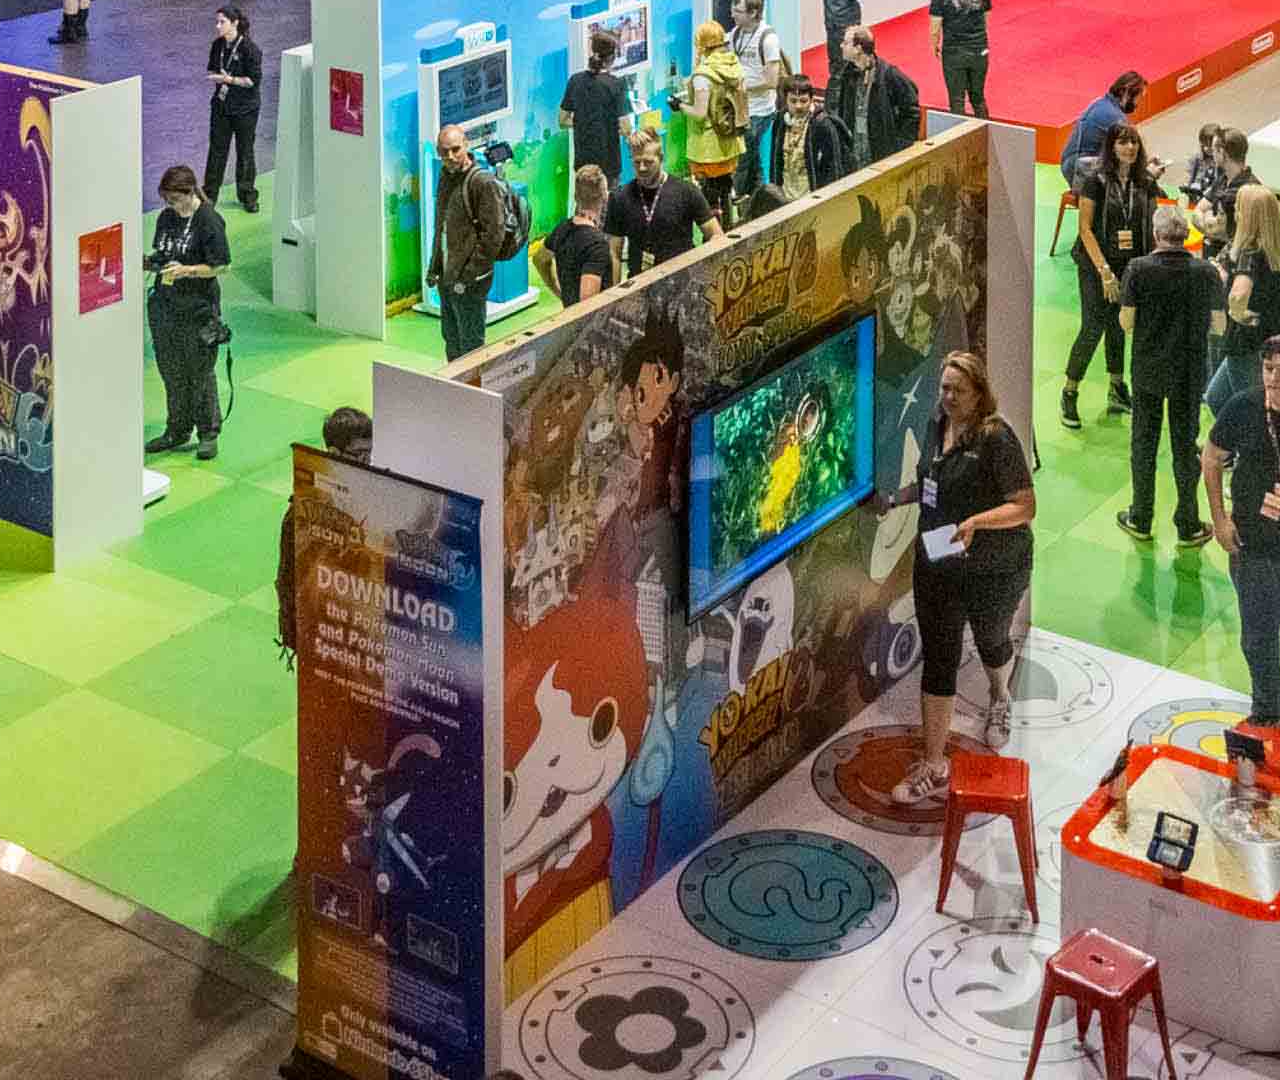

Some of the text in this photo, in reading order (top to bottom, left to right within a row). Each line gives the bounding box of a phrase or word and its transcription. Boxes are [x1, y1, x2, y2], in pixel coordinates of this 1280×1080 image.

[317, 565, 457, 633] DOWNLOAD
[326, 602, 349, 622] the
[318, 623, 344, 642] and
[314, 637, 362, 670] Special
[366, 655, 409, 683] Demo
[410, 673, 460, 707] Version
